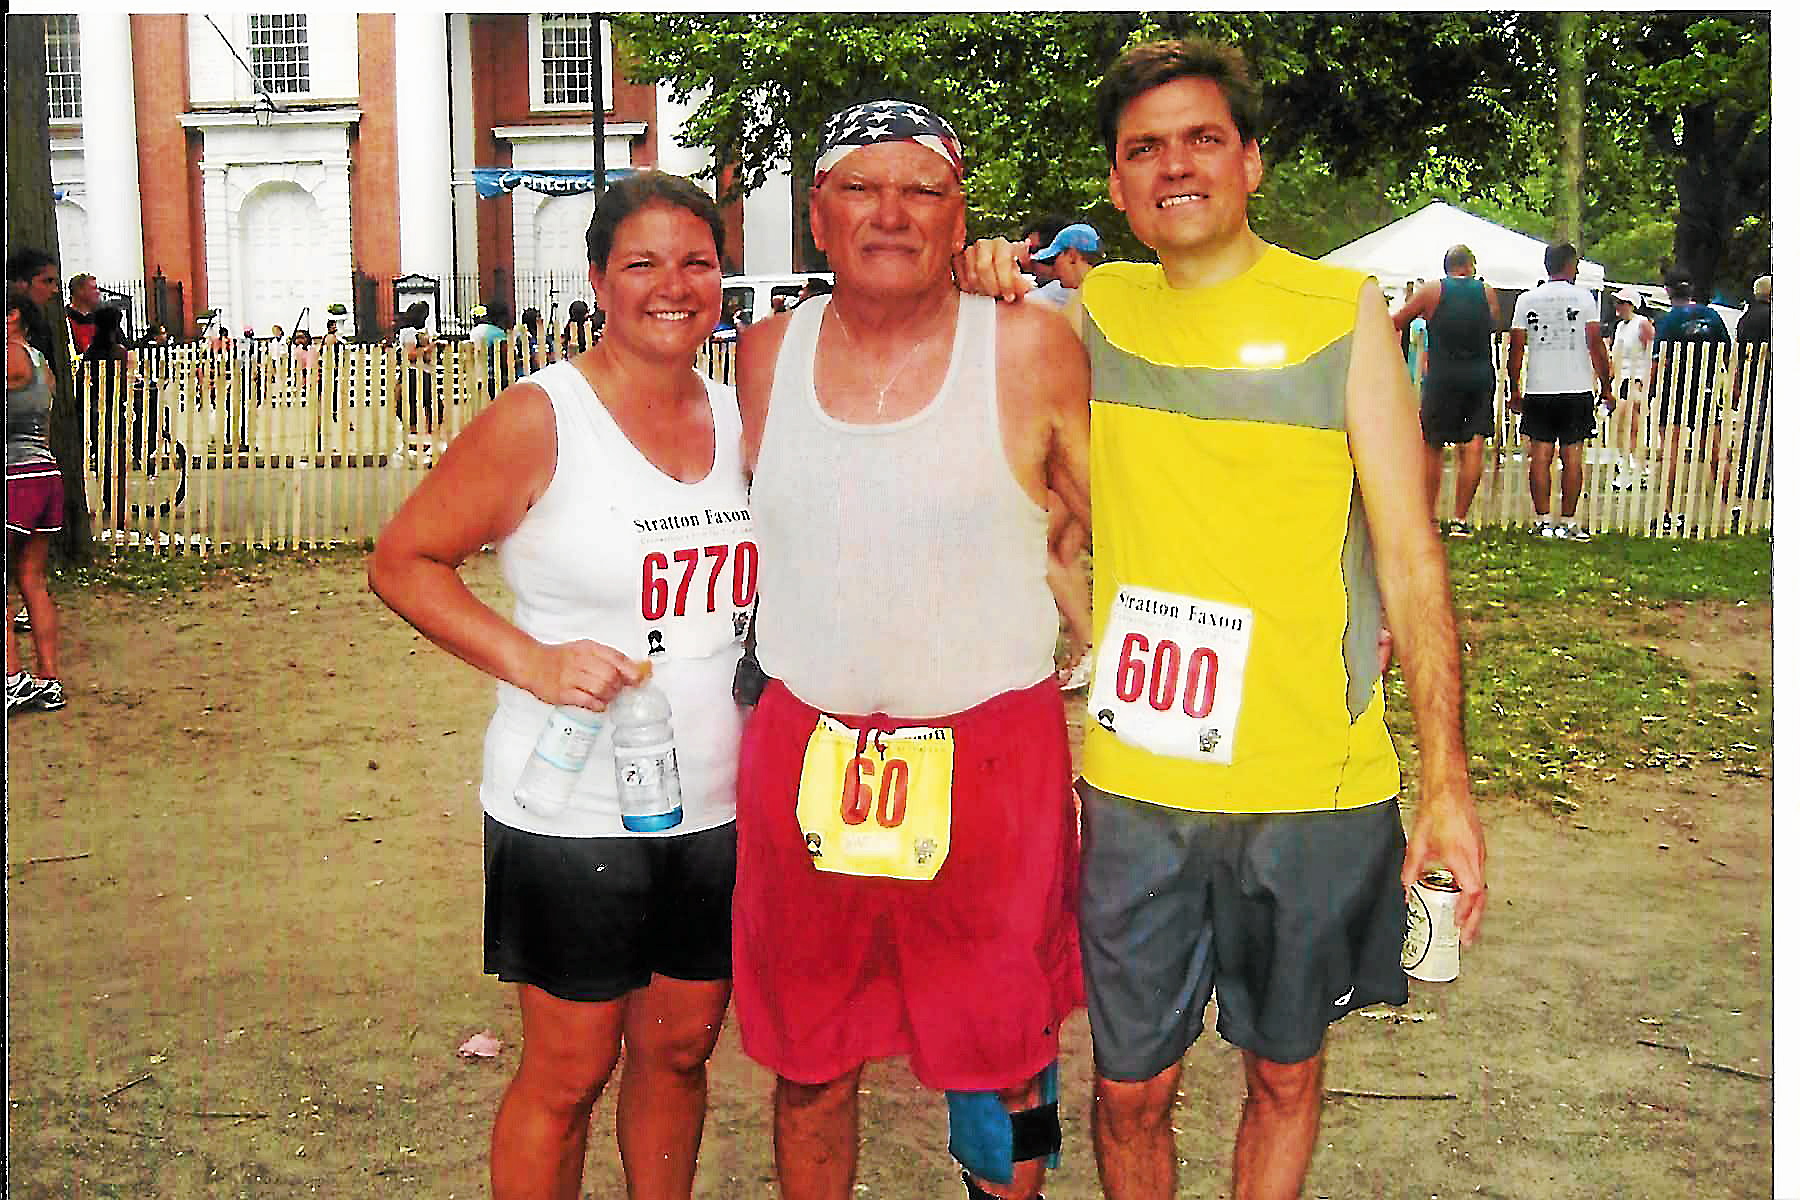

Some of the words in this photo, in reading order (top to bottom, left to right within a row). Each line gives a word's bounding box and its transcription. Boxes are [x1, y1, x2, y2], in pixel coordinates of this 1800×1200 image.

[633, 514, 700, 533] Stratton
[704, 509, 751, 525] Faxon
[641, 541, 759, 621] 6770
[1189, 605, 1243, 631] Faxon
[1116, 632, 1219, 719] 600
[840, 757, 909, 829] 60
